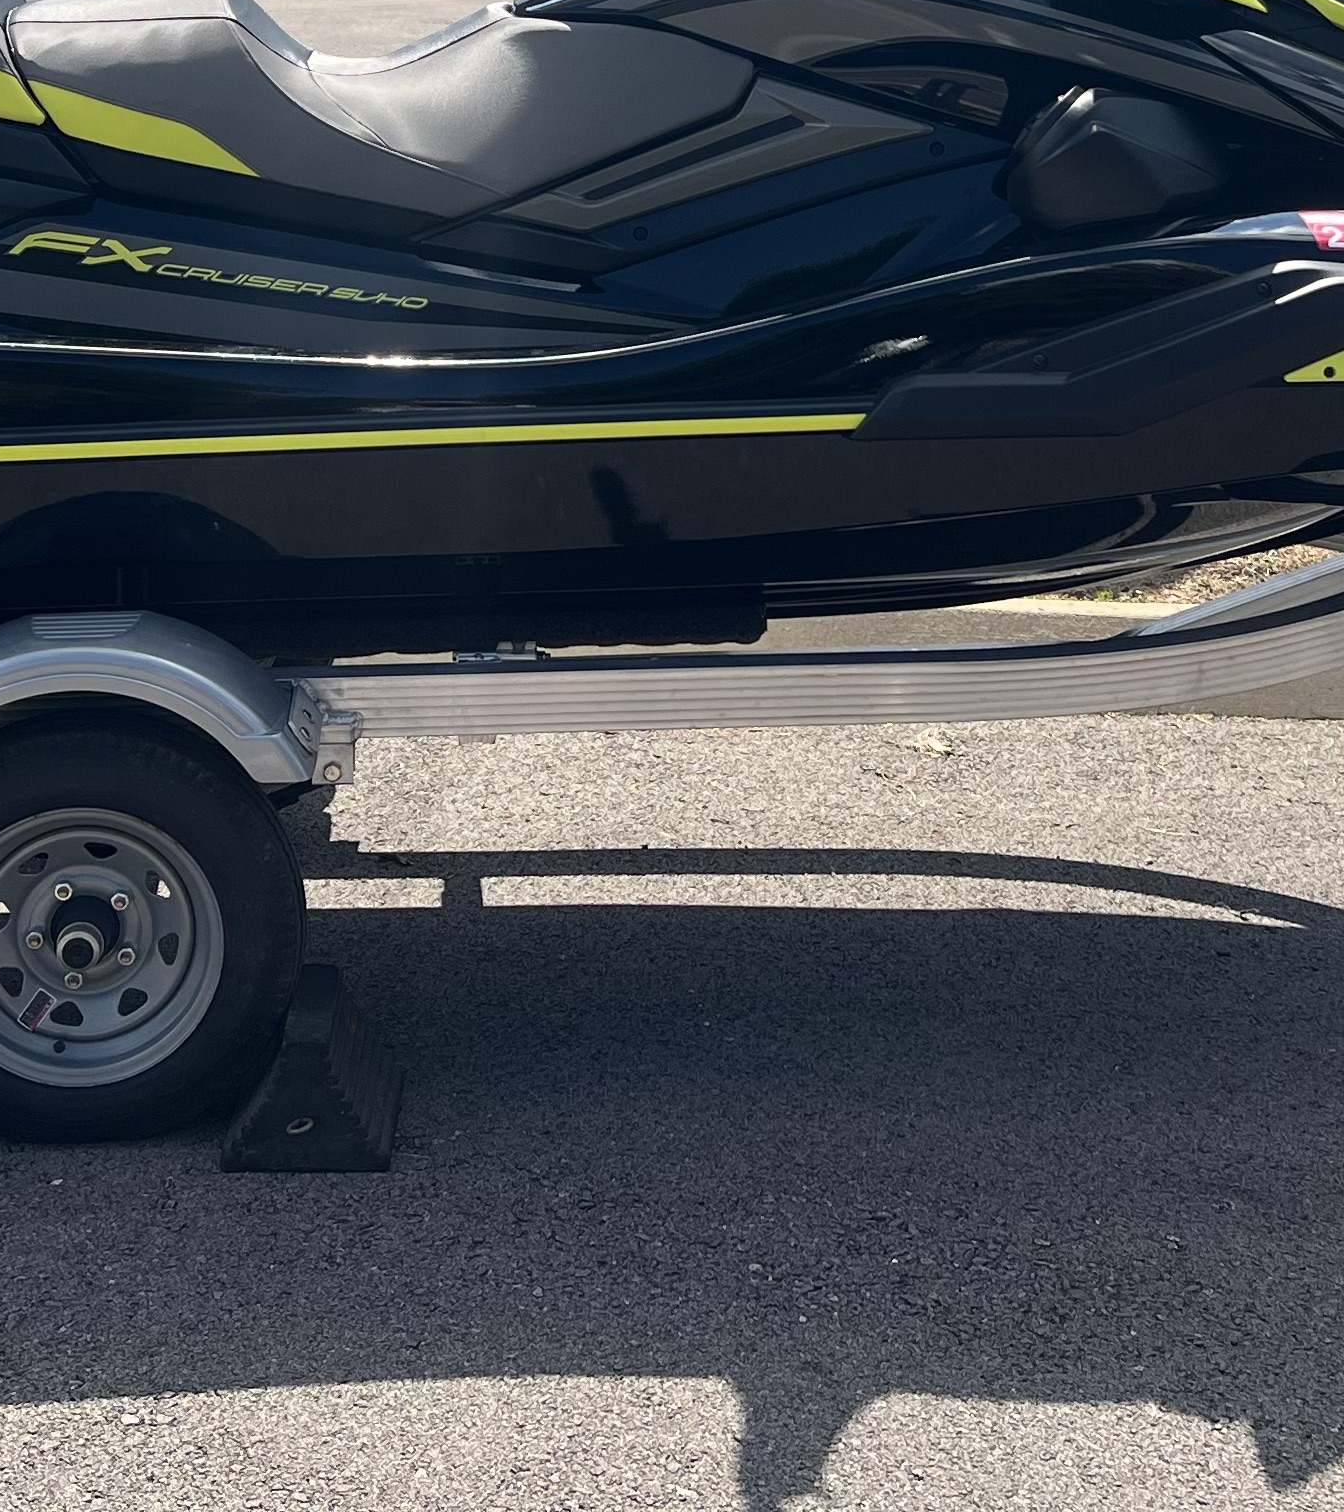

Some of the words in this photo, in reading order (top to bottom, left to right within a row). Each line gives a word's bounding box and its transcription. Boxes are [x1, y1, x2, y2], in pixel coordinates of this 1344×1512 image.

[8, 230, 173, 272] FX
[156, 263, 331, 297] CRUISER
[329, 287, 429, 310] SVHO
